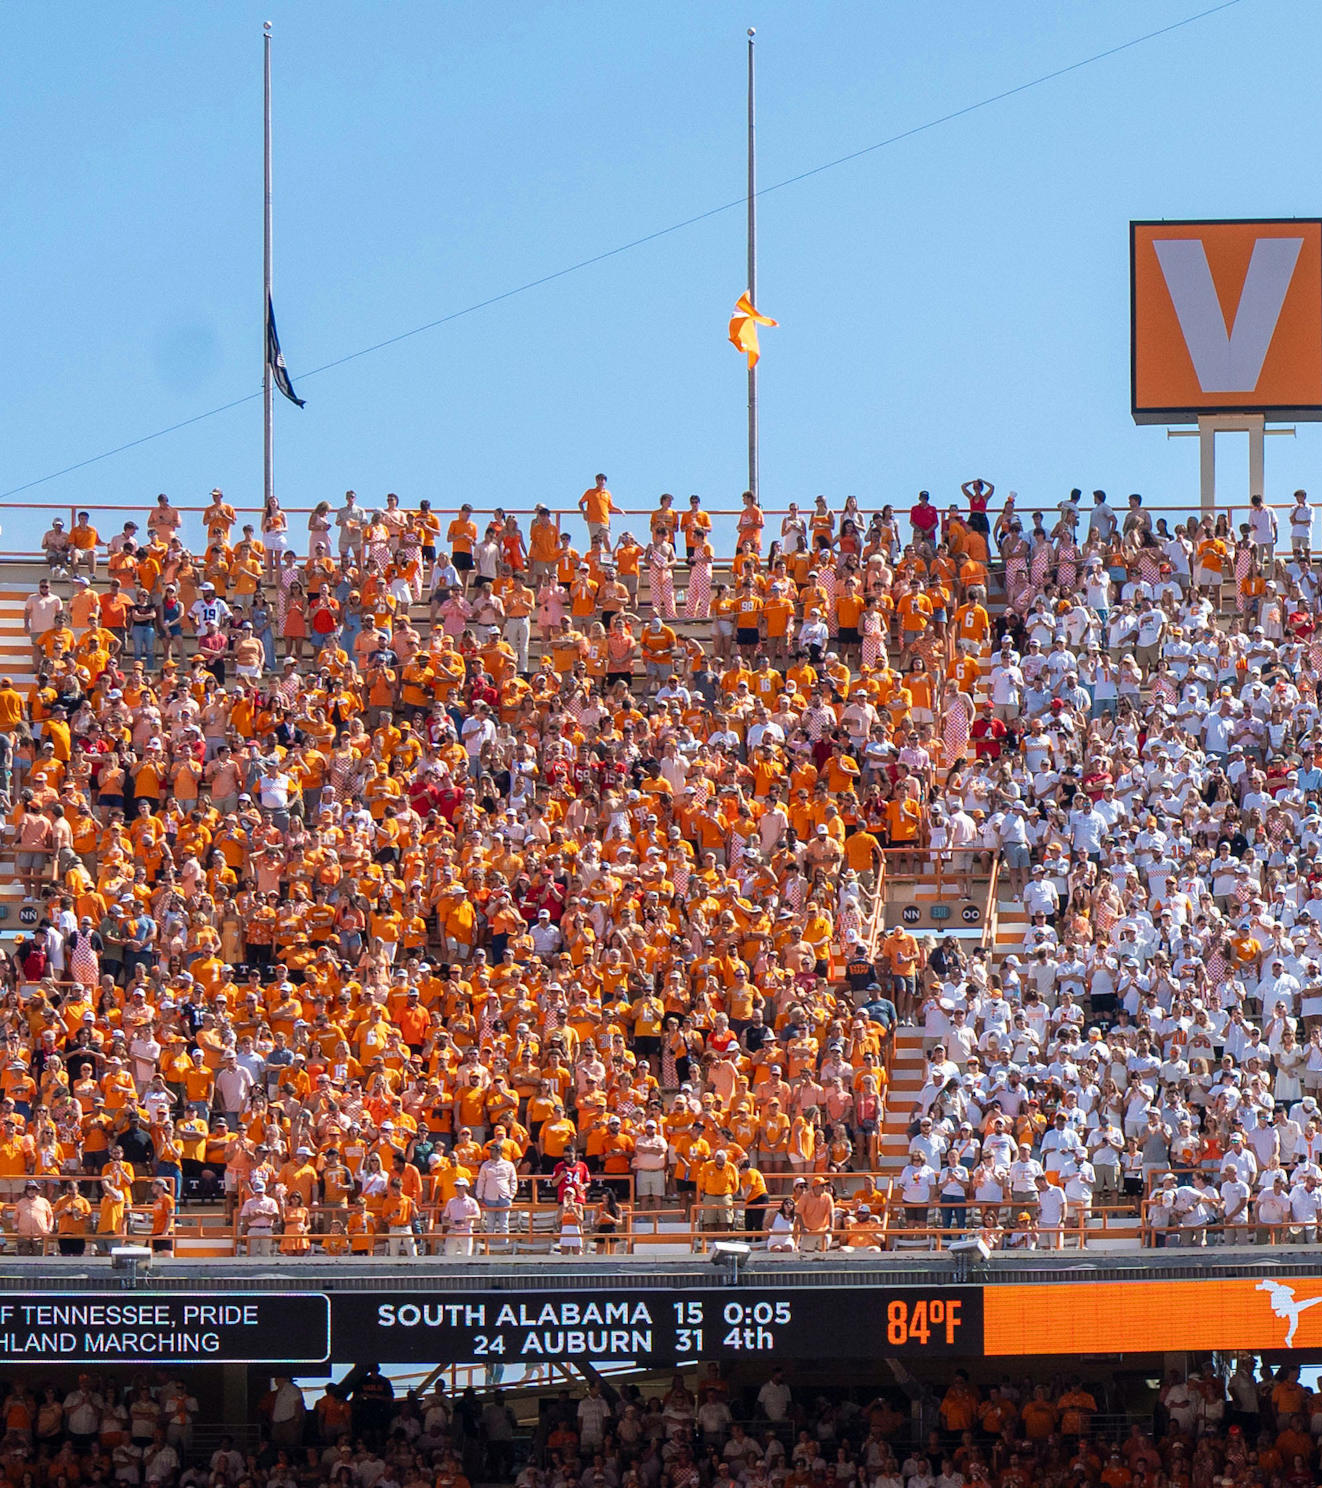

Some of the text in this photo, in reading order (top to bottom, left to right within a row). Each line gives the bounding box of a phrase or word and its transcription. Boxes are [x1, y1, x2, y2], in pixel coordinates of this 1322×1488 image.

[1152, 237, 1305, 393] V
[964, 612, 974, 628] 6
[956, 663, 965, 679] 6
[20, 911, 37, 920] NN
[903, 909, 920, 918] NN
[962, 909, 979, 918] OO
[240, 966, 251, 974] T
[267, 965, 276, 974] T
[191, 1180, 201, 1189] T
[21, 1306, 176, 1328] TENNESSEE,
[184, 1306, 258, 1325] PRIDE
[377, 1302, 792, 1327] SOUTH ALABAMA 15 0:05
[85, 1333, 220, 1353] MARCHING
[474, 1328, 774, 1355] 24 AUBURN 31 4th
